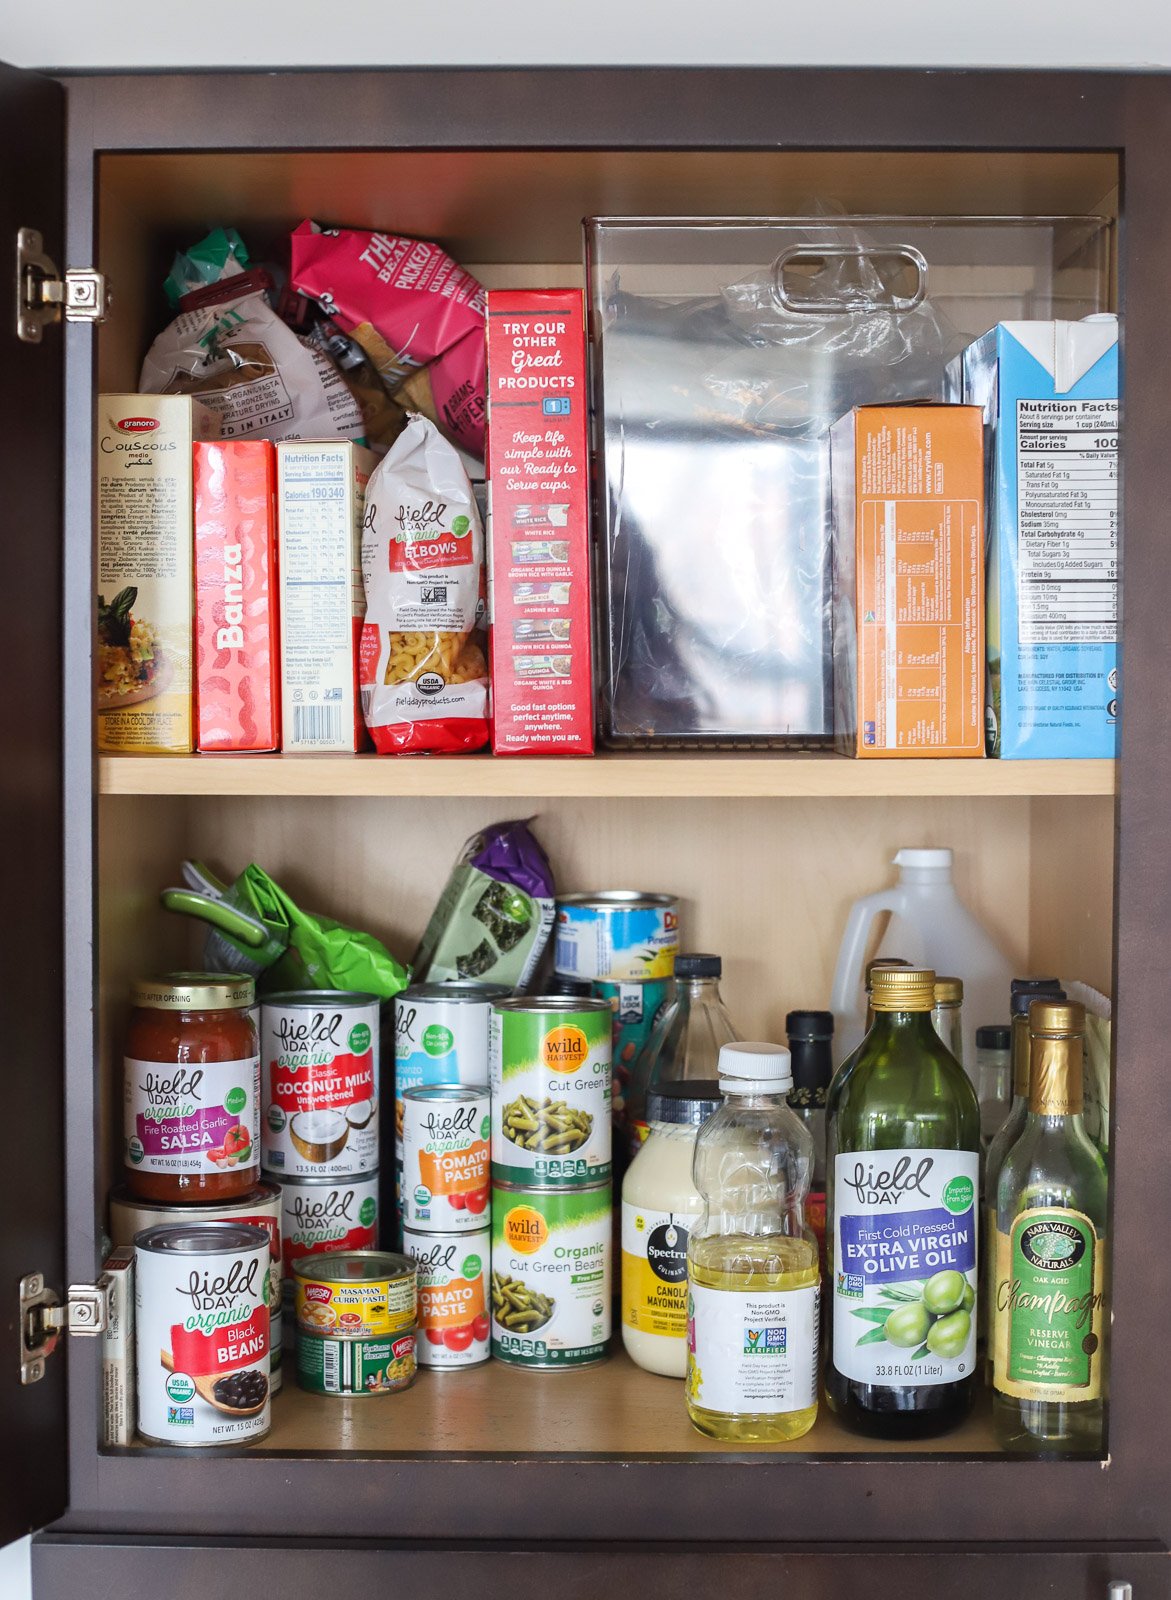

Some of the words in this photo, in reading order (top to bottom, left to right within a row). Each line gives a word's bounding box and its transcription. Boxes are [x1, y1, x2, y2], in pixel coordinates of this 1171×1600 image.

[359, 232, 397, 271] THE
[377, 239, 412, 283] BEAN
[395, 243, 432, 289] PACKED
[503, 323, 530, 334] TRY
[534, 323, 566, 334] OUR
[513, 337, 557, 347] OTHER
[511, 350, 562, 373] Great
[498, 376, 575, 388] PRODUCTS
[236, 396, 264, 408] BRONZE
[255, 398, 281, 412] DRYING
[1020, 402, 1077, 412] Nutrition
[1082, 402, 1118, 412] Facts
[124, 420, 155, 429] granoro
[241, 422, 254, 431] IN
[260, 408, 291, 425] ITALY
[1020, 421, 1041, 429] Serving
[100, 436, 177, 454] Couscous
[513, 432, 543, 446] Keep
[545, 431, 565, 446] life
[1020, 441, 1066, 449] Calories
[1094, 439, 1118, 448] 100
[285, 454, 319, 463] Nutrition
[321, 454, 344, 463] Facts
[505, 447, 544, 462] simple
[545, 447, 572, 459] with
[124, 458, 153, 469] كسكسي
[500, 465, 522, 475] our
[524, 463, 562, 478] Ready
[564, 463, 577, 474] to
[285, 491, 310, 499] Calories
[311, 487, 326, 498] 190
[328, 487, 345, 498] 340
[506, 479, 539, 490] Serve
[540, 480, 571, 494] cups.
[394, 501, 447, 530] field
[1043, 521, 1059, 529] 35mg
[1037, 530, 1076, 538] Carbohydrate
[405, 542, 457, 559] ELBOWS
[216, 543, 244, 650] Banza
[395, 696, 465, 708] fielddayproducts.com
[547, 703, 576, 712] options
[105, 717, 119, 725] STORE
[131, 717, 145, 725] COOL
[513, 714, 540, 722] perfect
[541, 713, 573, 722] anytime,
[524, 723, 562, 731] anywhere.
[273, 1013, 343, 1051] field
[290, 1042, 318, 1052] DAY
[547, 1038, 581, 1053] wild
[278, 1050, 332, 1071] organic
[547, 1053, 582, 1061] HARVEST
[139, 1069, 204, 1104] field
[277, 1078, 342, 1095] COCONUT
[345, 1070, 371, 1088] MILK
[549, 1080, 571, 1091] Cut
[575, 1079, 603, 1090] Green
[155, 1095, 179, 1105] DAY
[297, 1088, 354, 1104] unsweetened
[144, 1103, 195, 1122] organic
[144, 1126, 160, 1134] Fire
[161, 1121, 198, 1133] Roasted
[201, 1117, 228, 1130] Garlic
[420, 1107, 477, 1140] field
[161, 1132, 213, 1150] SALSA
[437, 1131, 460, 1139] DAY
[426, 1138, 471, 1154] organic
[190, 1159, 202, 1168] 454g
[433, 1149, 488, 1170] TOMATO
[444, 1164, 484, 1183] PASTE
[844, 1156, 934, 1204] field
[867, 1192, 902, 1204] DAY
[285, 1190, 355, 1229] field
[305, 1219, 331, 1229] DAY
[508, 1220, 540, 1235] wild
[858, 1229, 881, 1241] First
[883, 1226, 910, 1239] Cold
[913, 1219, 955, 1235] Pressed
[1027, 1224, 1049, 1237] NAPA
[1050, 1224, 1080, 1238] VALLEY
[292, 1225, 346, 1247] organic
[554, 1242, 604, 1259] Organic
[847, 1240, 904, 1258] EXTRA
[908, 1230, 968, 1252] VIRGIN
[648, 1246, 687, 1258] Spectru
[510, 1259, 528, 1271] Cut
[533, 1260, 571, 1273] Green
[575, 1257, 604, 1271] Beans
[864, 1256, 920, 1274] OLIVE
[925, 1250, 957, 1267] OIL
[1031, 1255, 1074, 1269] NATURALS
[658, 1264, 685, 1275] CULINARY
[176, 1258, 259, 1310] field
[656, 1286, 687, 1297] CANOLA
[203, 1297, 236, 1310] DAY
[333, 1296, 360, 1304] CURRY
[362, 1295, 387, 1303] PASTE
[647, 1296, 686, 1309] MAYONNA
[997, 1279, 1104, 1329] Champagn
[423, 1303, 467, 1317] PASTE
[186, 1303, 252, 1333] organic
[227, 1324, 255, 1342] Black
[1030, 1329, 1070, 1339] RESERVE
[217, 1334, 265, 1363] BEANS
[1027, 1339, 1071, 1349] VINEGAR
[876, 1366, 893, 1376] 33.8
[894, 1366, 902, 1375] FL
[904, 1366, 914, 1375] OZ
[914, 1365, 922, 1376] (1
[924, 1365, 943, 1376] Liter)
[172, 1379, 189, 1387] USDA
[213, 1426, 225, 1434] NET
